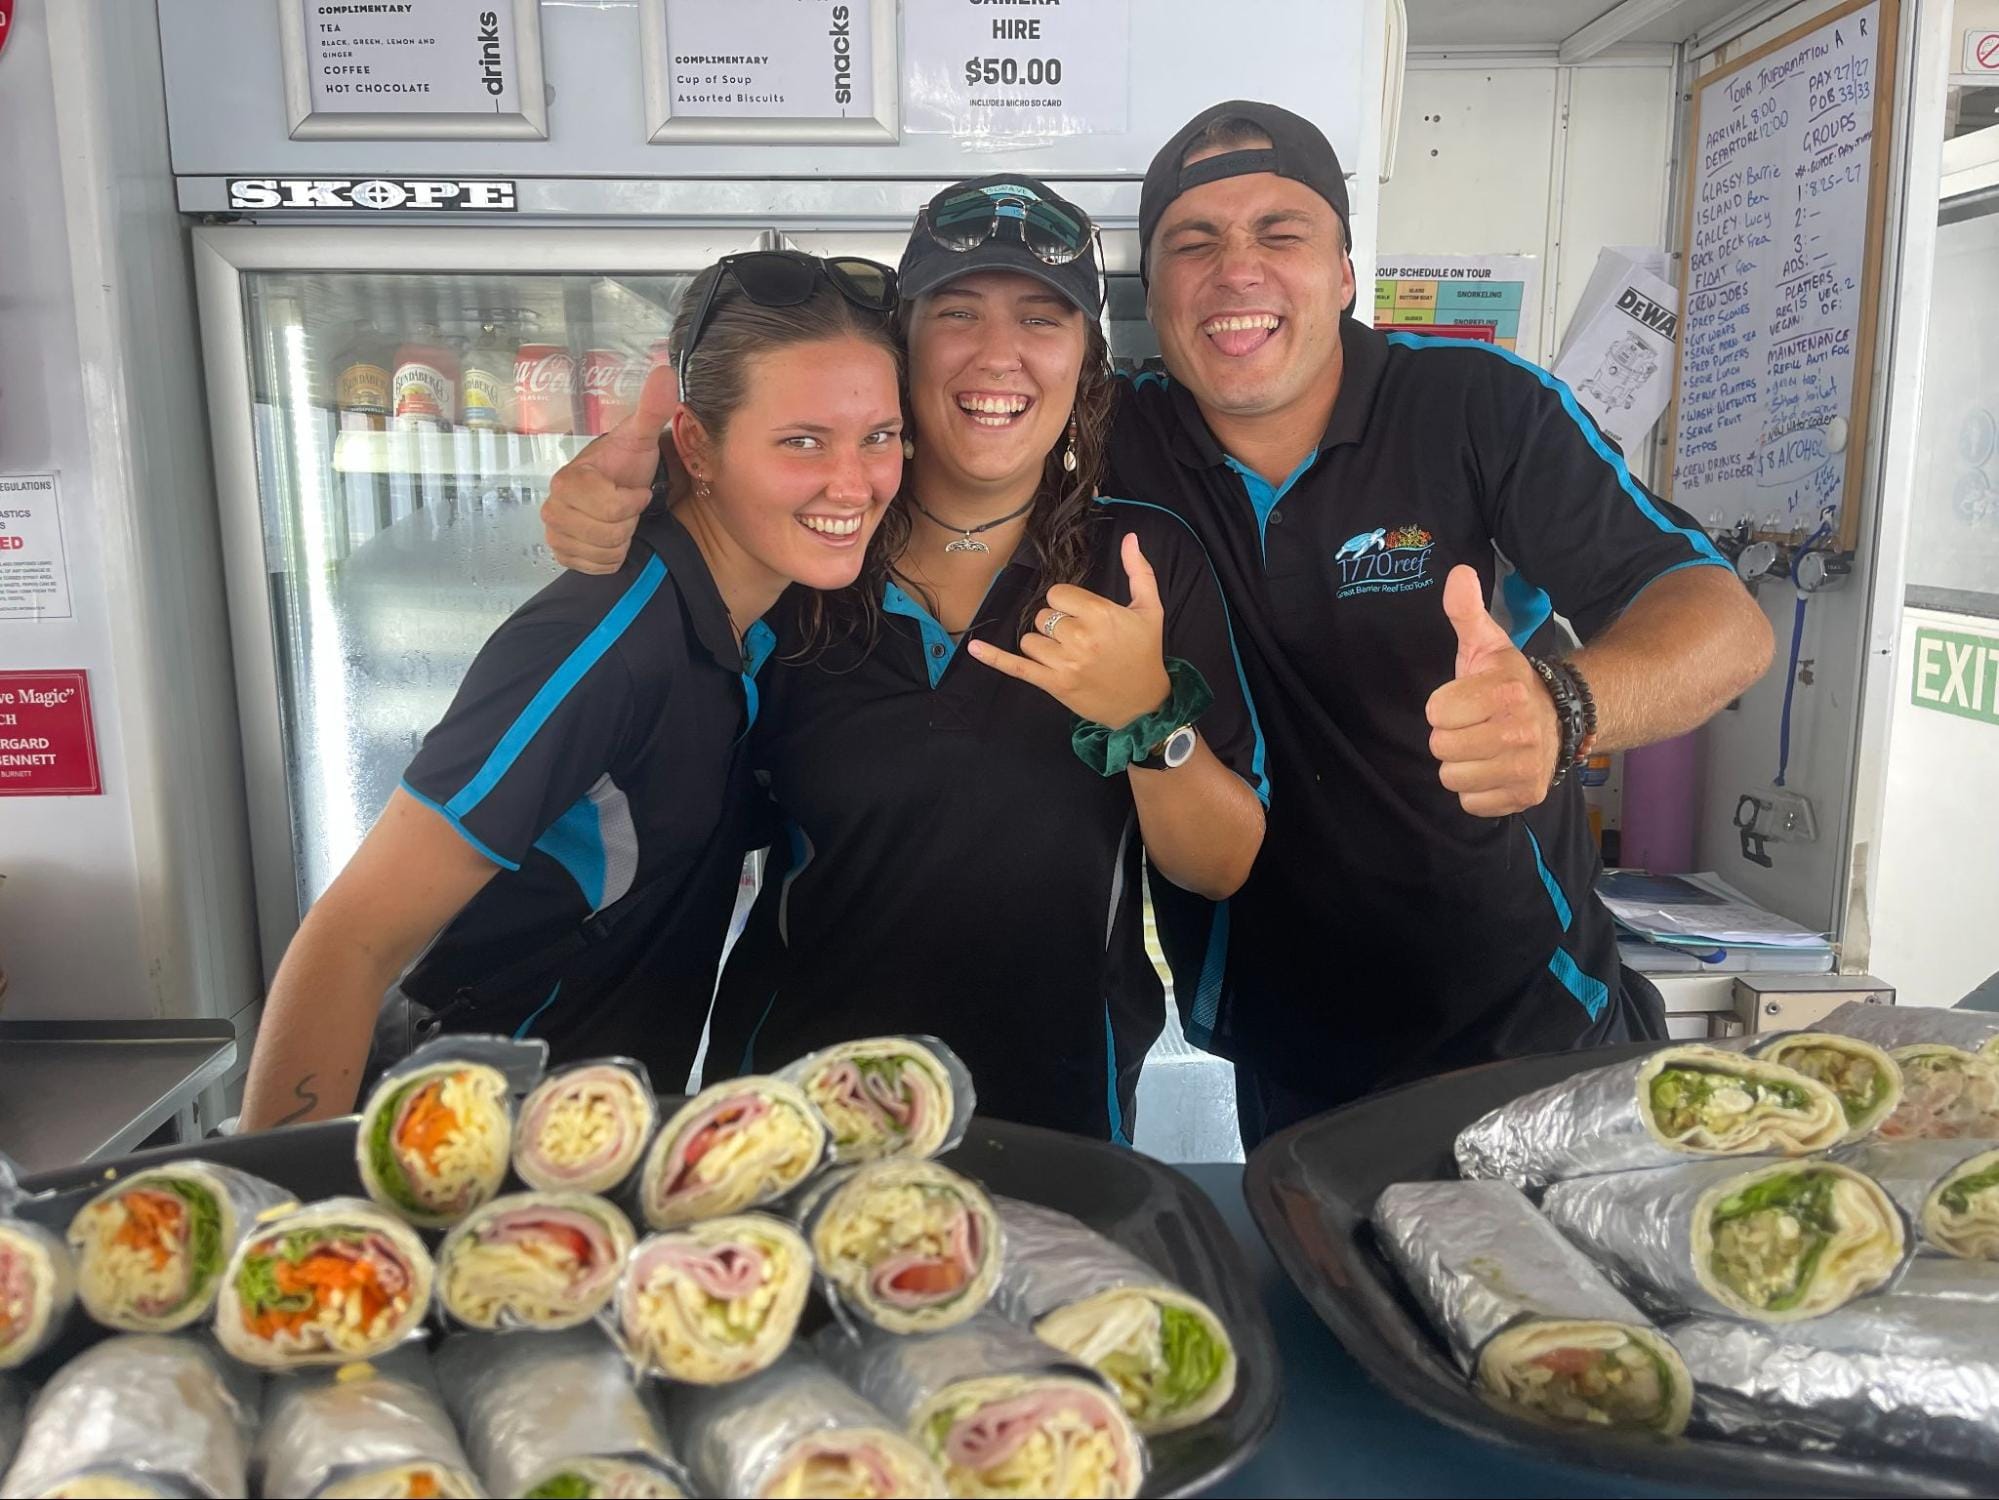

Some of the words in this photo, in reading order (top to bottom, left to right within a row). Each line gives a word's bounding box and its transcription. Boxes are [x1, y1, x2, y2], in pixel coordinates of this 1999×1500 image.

[318, 4, 412, 14] COMPLIMENTARY
[320, 24, 341, 32] TEA
[992, 19, 1041, 39] HIRE
[1835, 29, 1844, 49] A
[1860, 18, 1868, 37] R
[477, 11, 504, 95] drinks
[675, 56, 768, 64] COMPLIMENTARY
[829, 5, 851, 104] snacks
[324, 65, 371, 75] COFFEE
[965, 56, 1062, 86] $50.00
[1757, 44, 1829, 89] INFORMATION
[326, 84, 350, 93] HOT
[355, 83, 430, 93] CHOCOLATE
[676, 75, 700, 85] Cup
[705, 75, 718, 84] of
[722, 75, 752, 85] Soup
[1809, 70, 1832, 93] PAX
[678, 94, 732, 103] Assorted
[737, 94, 784, 103] Biscuits
[969, 99, 1005, 107] INCLUDES
[1006, 99, 1030, 107] MICRO
[1031, 99, 1041, 107] SD
[1042, 99, 1062, 107] CARD
[1706, 114, 1748, 149] ARRIVAL
[1803, 112, 1856, 153] GROUPS
[231, 180, 514, 209] SKOPE
[1702, 171, 1742, 203] GLASSY
[1697, 194, 1742, 225] ISLAND
[1696, 215, 1737, 250] GALLEY
[1745, 211, 1771, 229] Lucy
[1691, 252, 1714, 272] BACK
[1719, 233, 1744, 259] DECK
[1400, 268, 1449, 277] SCHEDULE
[1450, 269, 1464, 278] ON
[1467, 269, 1492, 278] TOUR
[1696, 264, 1728, 290] FLOAT
[1785, 270, 1833, 300] PLATTERS
[1688, 293, 1717, 316] CREW
[1719, 281, 1748, 306] JOBS
[1616, 288, 1677, 340] DEWA
[1692, 314, 1715, 332] PREP
[1690, 333, 1706, 347] CUT
[1708, 323, 1736, 342] WRAPS
[1768, 328, 1850, 365] MAINTENANCE
[1831, 344, 1850, 356] FOG
[1718, 464, 1754, 482] FOLDER
[0, 481, 52, 492] EGULATIONS
[1356, 584, 1381, 594] Barrier
[1381, 583, 1399, 593] Reef
[1917, 637, 1999, 716] EXIT
